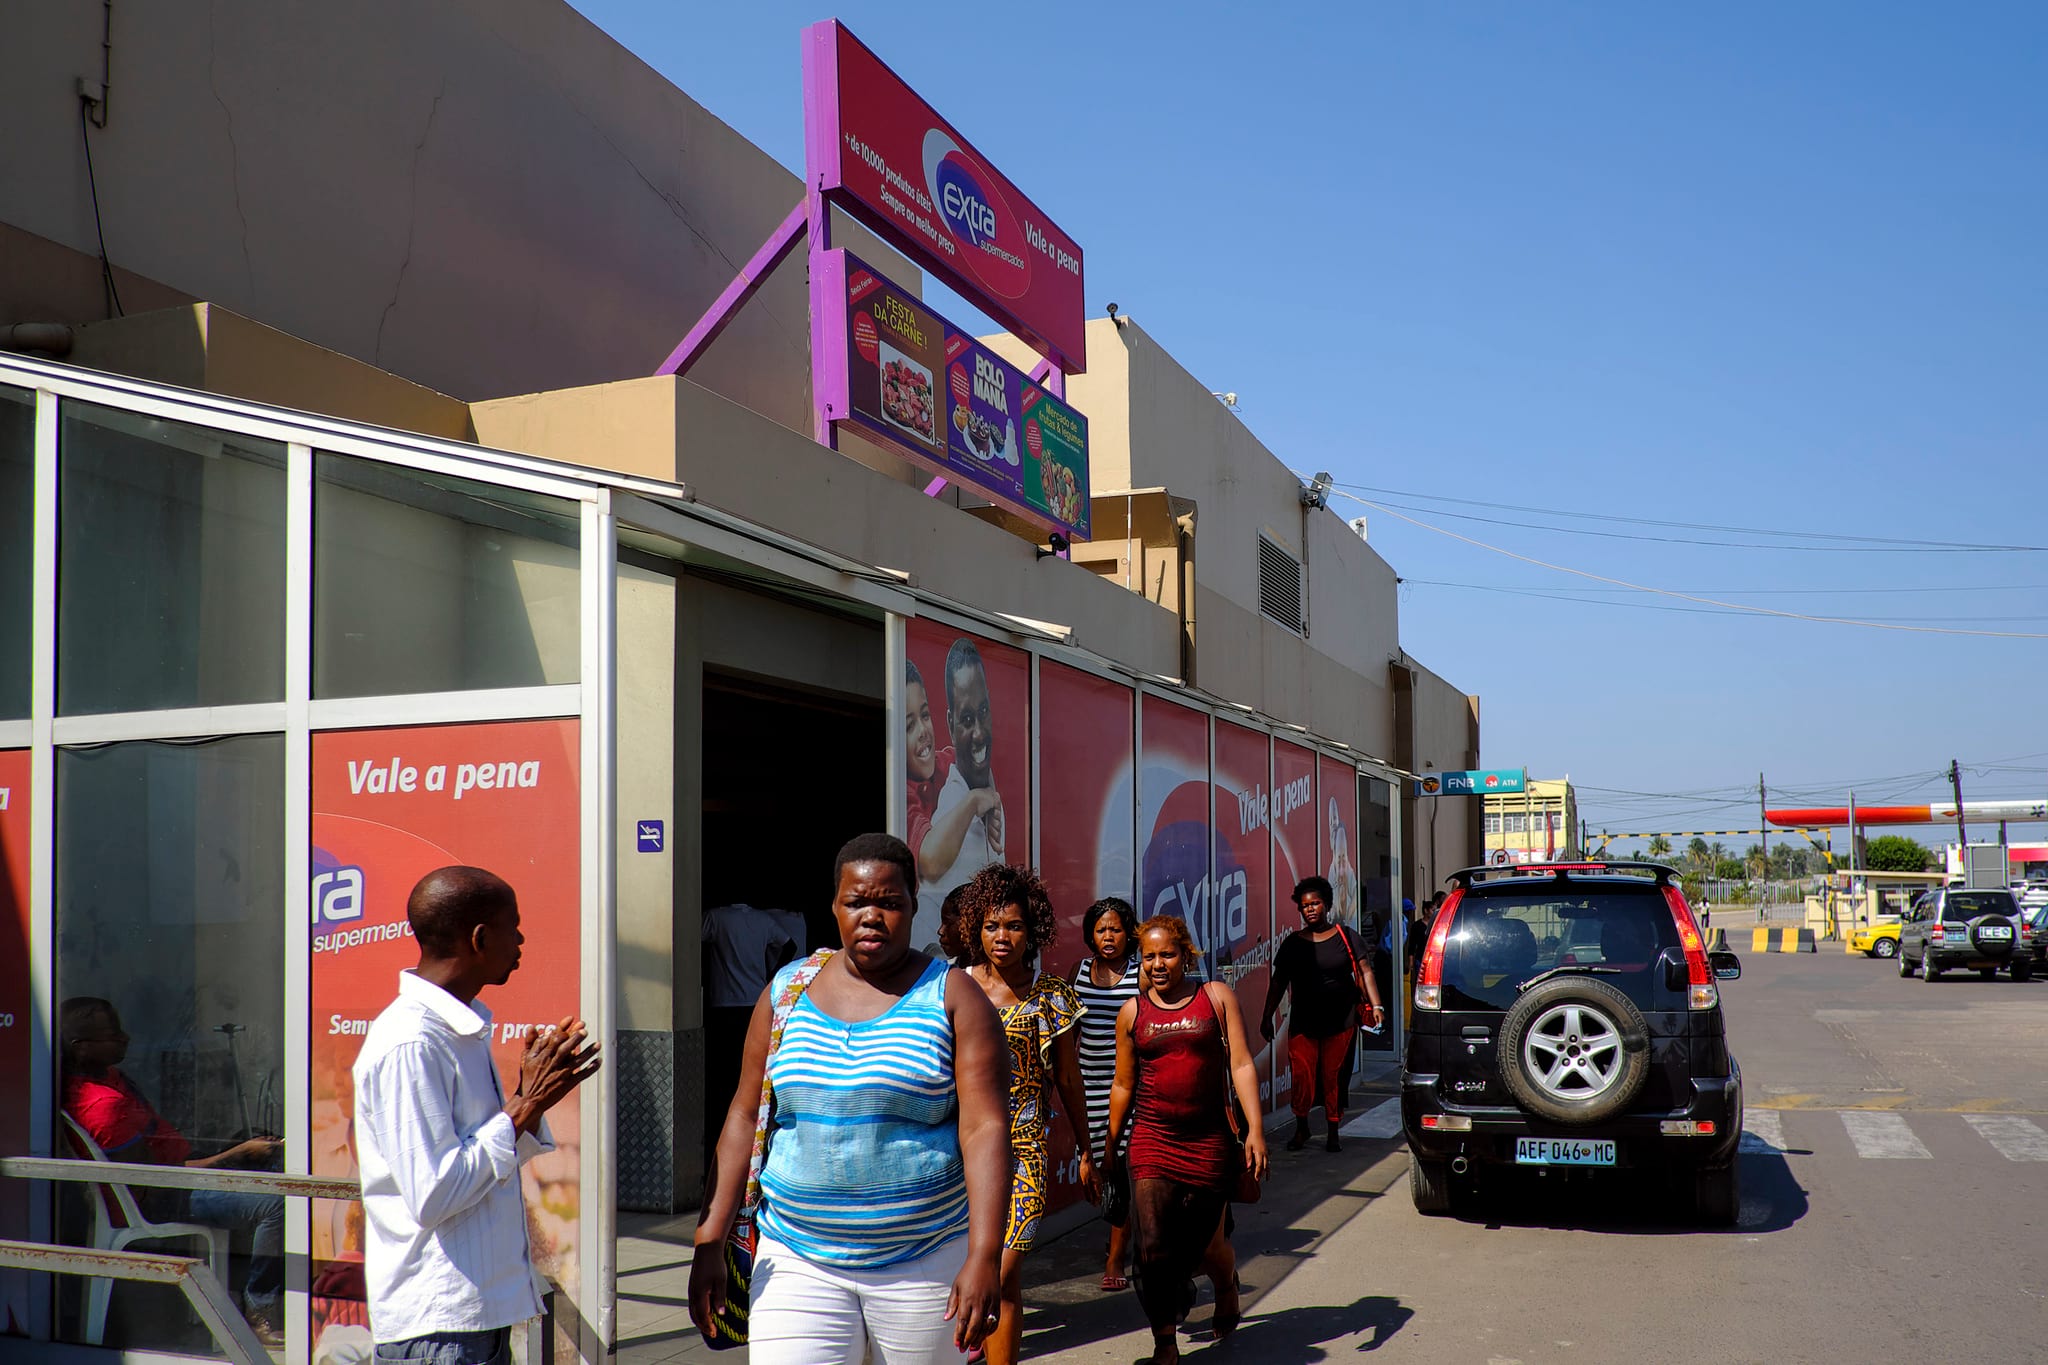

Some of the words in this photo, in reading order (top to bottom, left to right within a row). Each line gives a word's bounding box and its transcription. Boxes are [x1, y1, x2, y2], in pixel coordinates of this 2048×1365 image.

[850, 134, 860, 155] de
[861, 142, 885, 175] 10,000
[886, 166, 915, 200] produtos
[916, 188, 932, 214] úteis
[880, 184, 905, 217] Sempre
[906, 208, 915, 224] ao
[916, 213, 937, 242] melhor
[938, 233, 955, 256] preço
[943, 182, 996, 246] extra
[980, 239, 1025, 270] supermercados
[1025, 220, 1047, 254] Vale
[1048, 242, 1055, 260] a
[1057, 248, 1079, 276] pena
[874, 302, 888, 325] DA
[886, 295, 916, 328] FESTA
[975, 352, 1005, 391] BOLO
[973, 373, 1009, 417] MANIA
[347, 757, 418, 795] Vale
[425, 765, 446, 791] a
[453, 761, 540, 800] pena
[1447, 778, 1475, 789] FNB
[1502, 779, 1518, 787] ATM
[1238, 783, 1268, 836] Vale
[1273, 788, 1281, 819] a
[1284, 774, 1310, 825] pena
[313, 920, 415, 954] supermerc
[328, 1014, 373, 1035] Sem
[1275, 1065, 1292, 1096] melh
[1518, 1140, 1547, 1159] AEF
[1552, 1142, 1581, 1161] 046
[1594, 1143, 1614, 1162] MC
